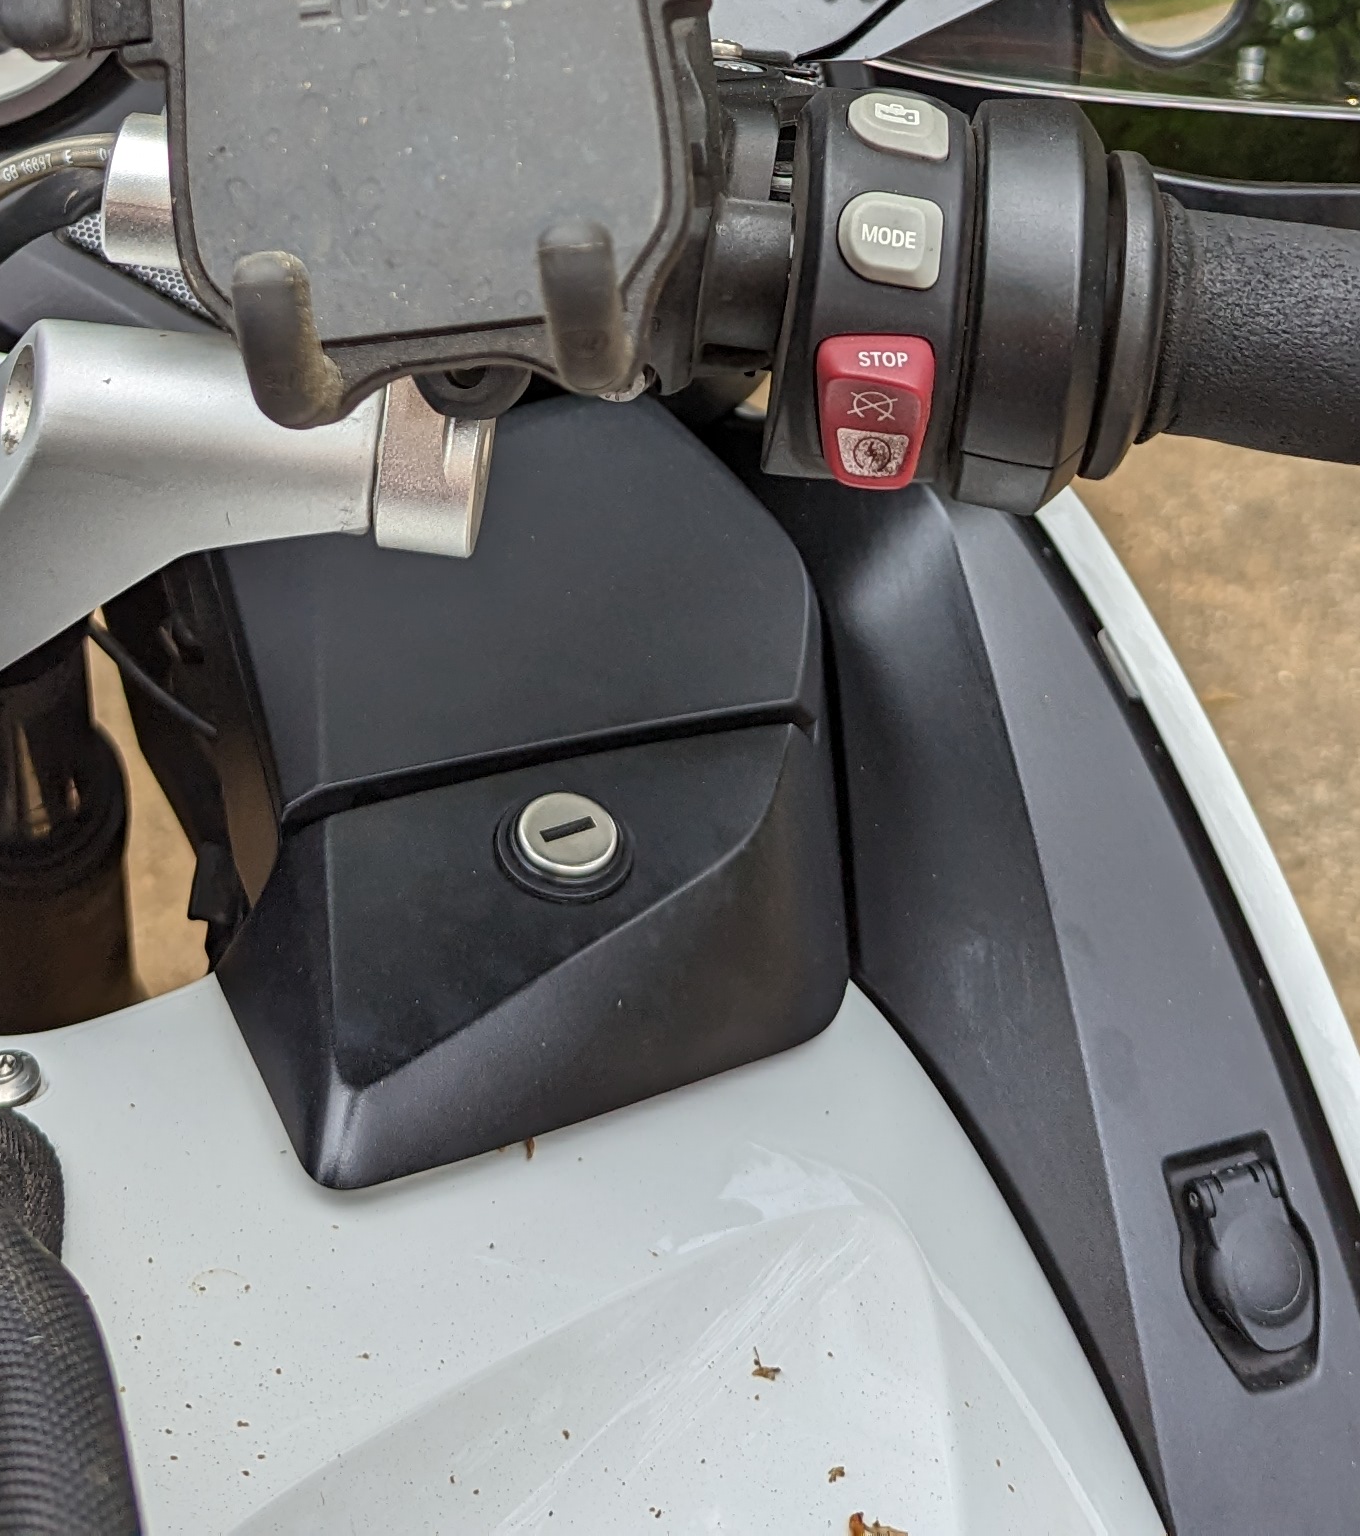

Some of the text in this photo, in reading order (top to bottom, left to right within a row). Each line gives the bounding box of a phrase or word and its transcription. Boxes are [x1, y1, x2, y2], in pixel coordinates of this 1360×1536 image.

[2, 164, 20, 183] GB
[20, 153, 52, 175] 16897
[861, 224, 917, 249] MODE
[858, 351, 909, 368] STOP
